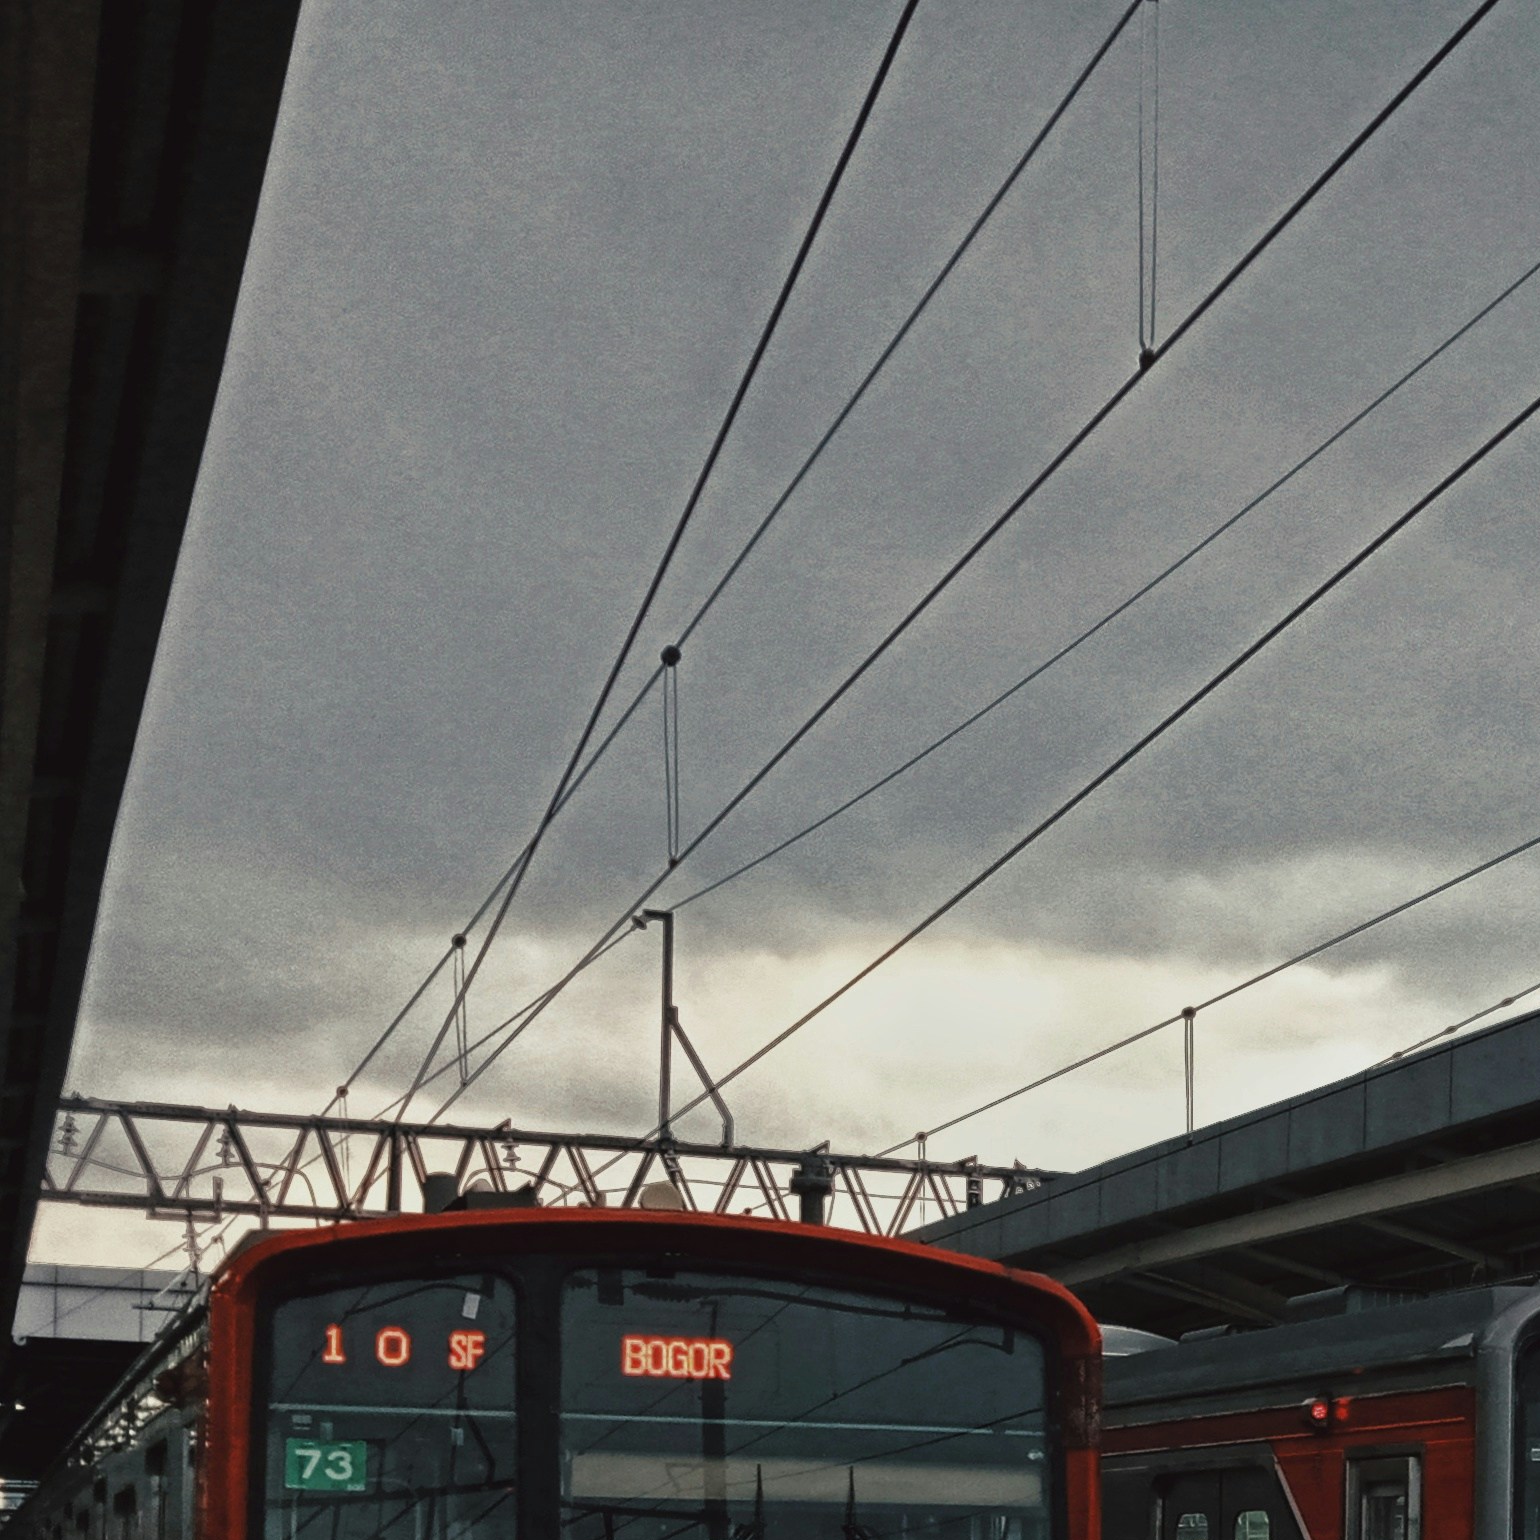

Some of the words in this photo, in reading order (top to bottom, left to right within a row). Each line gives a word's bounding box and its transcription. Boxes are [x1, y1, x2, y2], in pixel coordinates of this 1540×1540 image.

[449, 1331, 485, 1369] SF
[623, 1335, 732, 1379] BOGOR
[295, 1449, 353, 1480] 73
